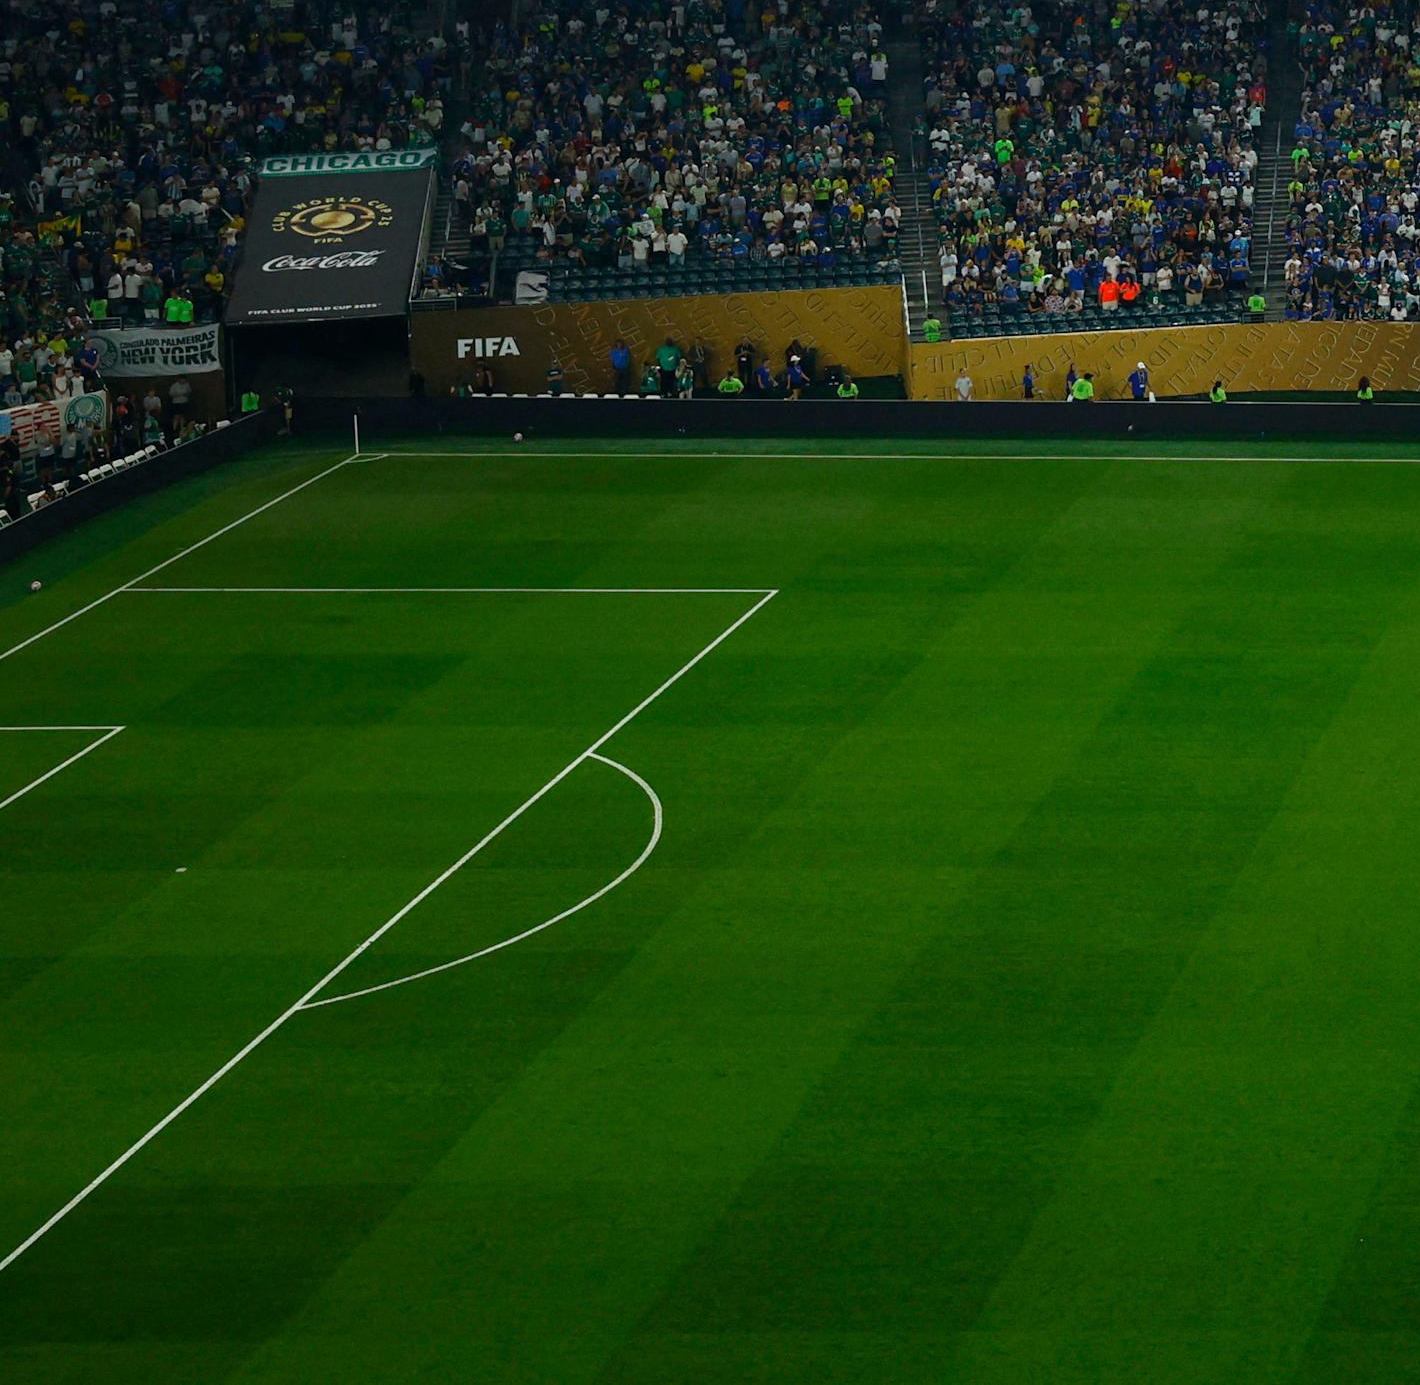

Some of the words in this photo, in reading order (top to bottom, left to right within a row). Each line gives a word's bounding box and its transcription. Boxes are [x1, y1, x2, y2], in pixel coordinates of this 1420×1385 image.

[266, 152, 421, 173] CHICAGO
[272, 211, 292, 232] CLUB
[292, 197, 362, 209] WORLD
[367, 200, 393, 214] CUP
[161, 330, 216, 346] PALMEIRAS
[457, 337, 521, 359] FIFA
[120, 346, 156, 365] NEW
[158, 340, 218, 366] YORK
